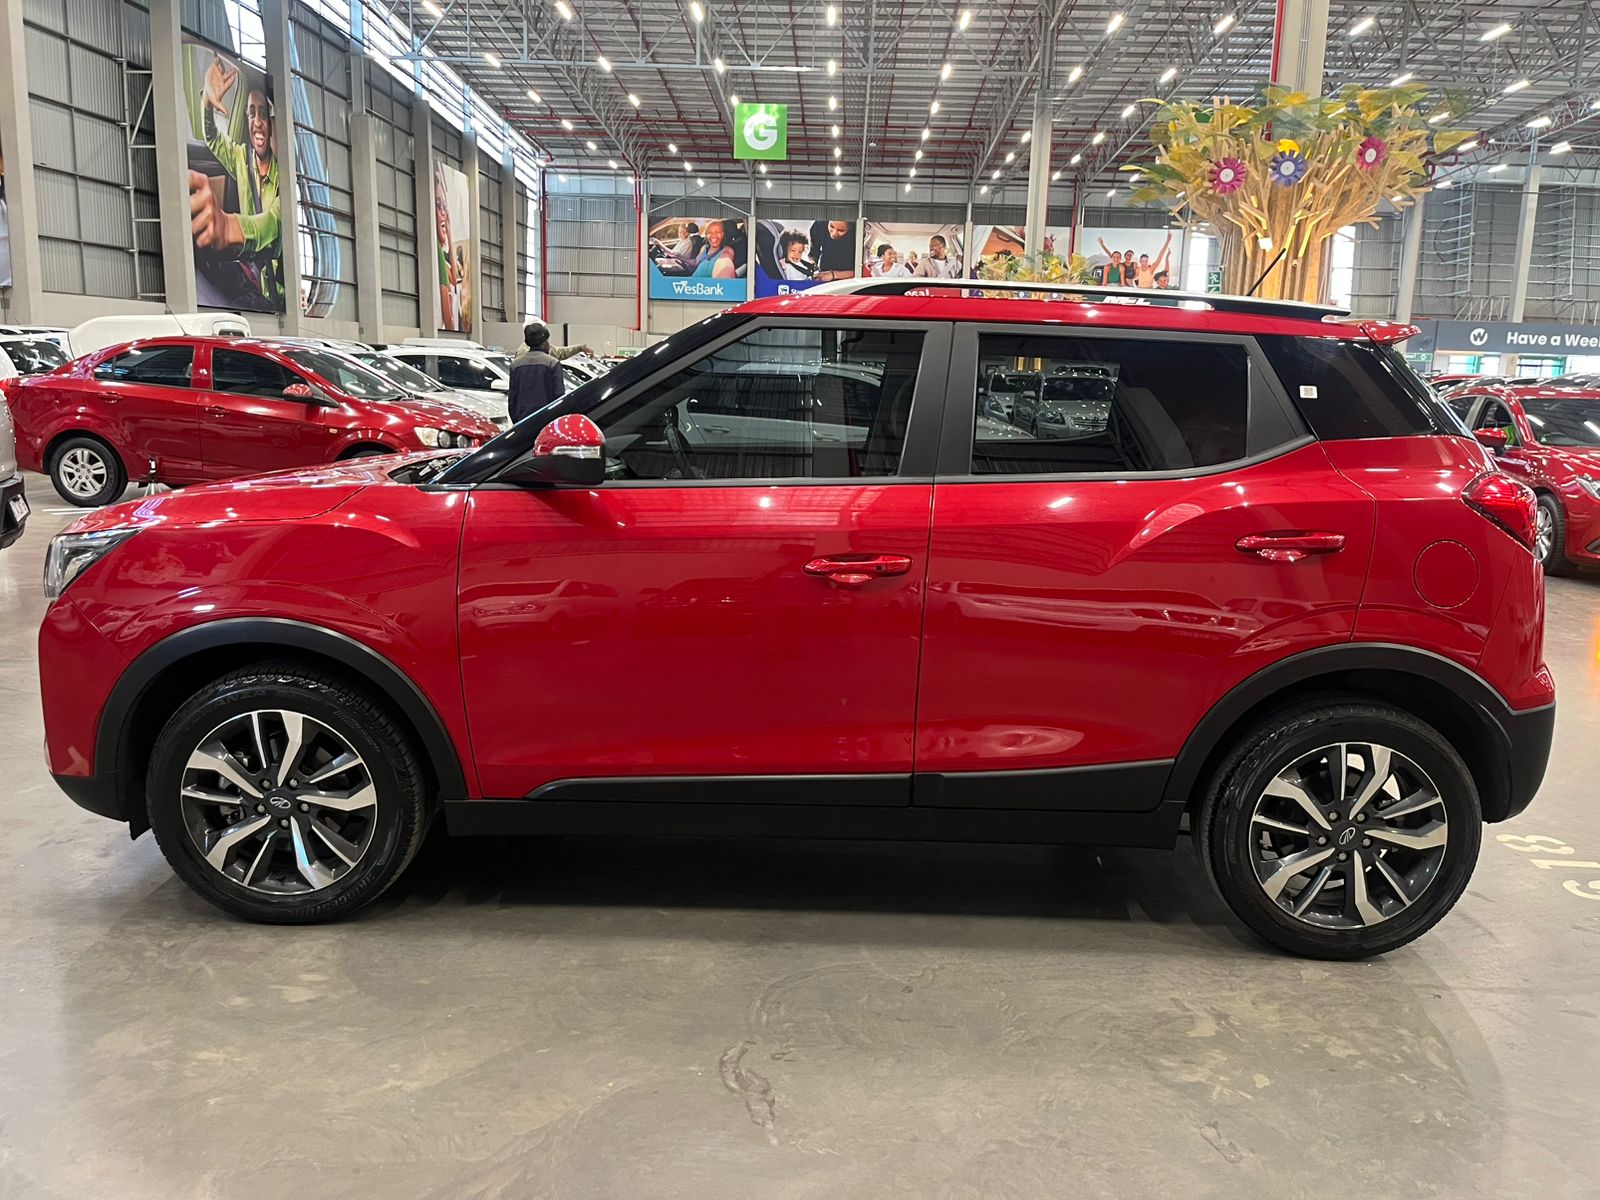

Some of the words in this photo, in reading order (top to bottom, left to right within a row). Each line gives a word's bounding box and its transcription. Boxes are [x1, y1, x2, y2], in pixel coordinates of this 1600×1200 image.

[743, 113, 778, 150] G
[672, 280, 724, 296] WesBank
[1506, 331, 1548, 345] Have
[1550, 335, 1561, 346] a
[1564, 333, 1600, 348] Wee
